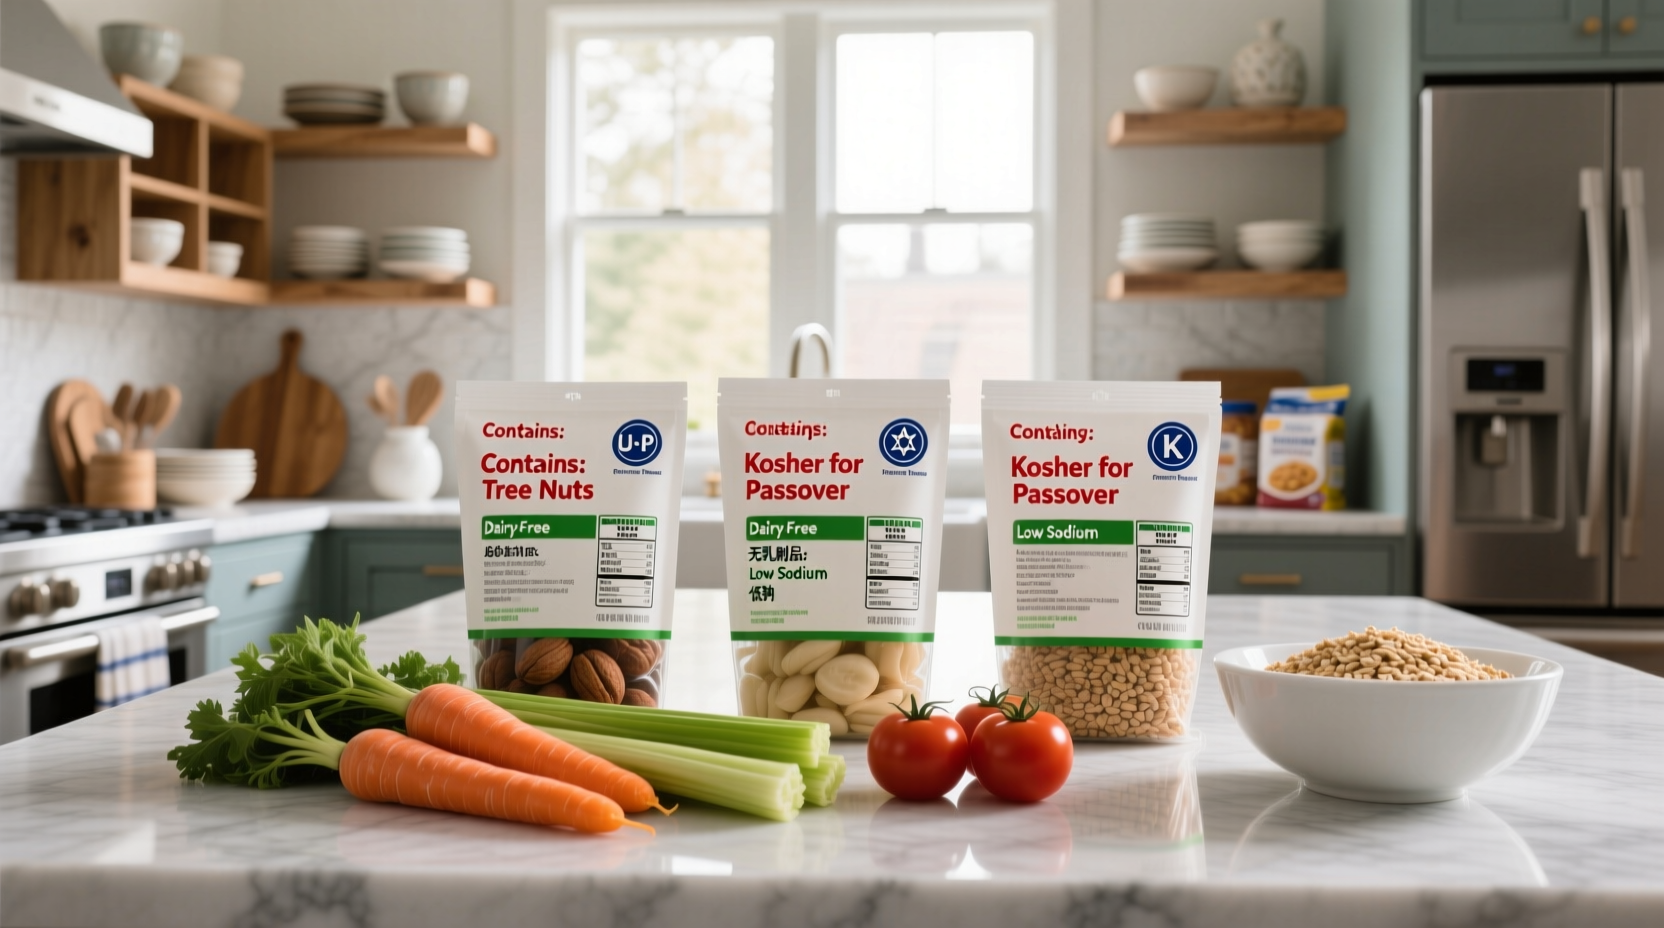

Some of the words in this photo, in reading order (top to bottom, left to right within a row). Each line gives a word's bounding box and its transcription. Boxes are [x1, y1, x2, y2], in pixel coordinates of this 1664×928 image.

[482, 421, 564, 439] Contains:
[1163, 434, 1184, 460] K
[481, 453, 586, 474] Contains:
[744, 452, 824, 474] Kosher
[829, 452, 864, 474] for
[1011, 455, 1093, 478] Kosher
[1099, 455, 1134, 478] for
[482, 479, 533, 500] Tree
[539, 480, 594, 500] Nuts
[746, 479, 850, 500] Passover
[1013, 483, 1120, 505] Passover
[484, 520, 518, 538] Dairy
[519, 520, 551, 534] Free
[749, 520, 784, 539] Dairy
[786, 521, 818, 534] Free
[1017, 525, 1044, 539] Low
[1046, 524, 1099, 539] Sodium
[749, 567, 775, 580] Low
[777, 566, 828, 580] Sodium
